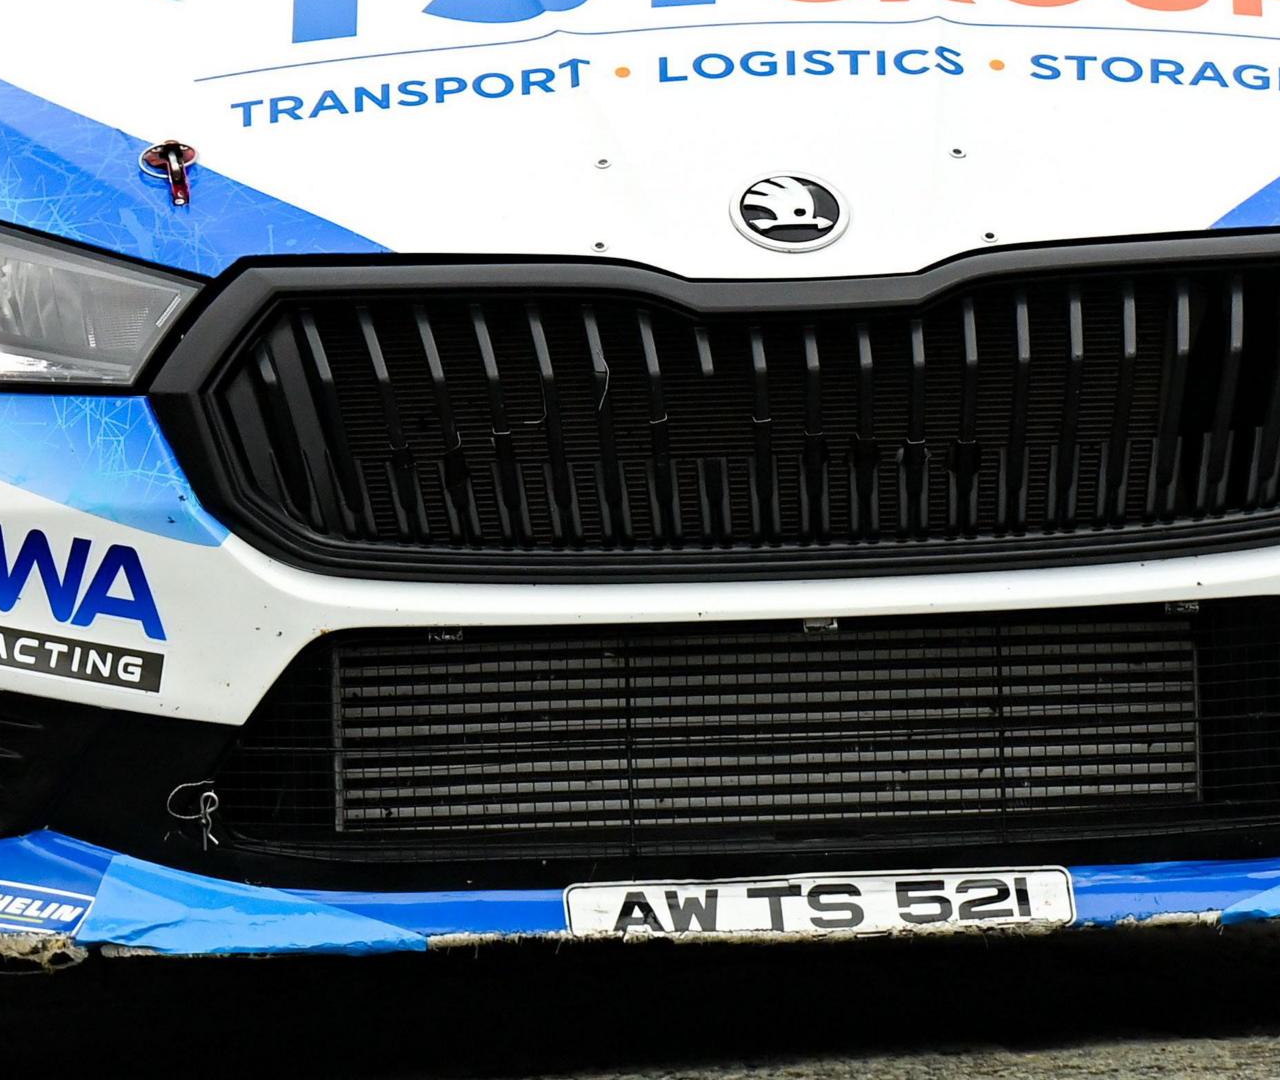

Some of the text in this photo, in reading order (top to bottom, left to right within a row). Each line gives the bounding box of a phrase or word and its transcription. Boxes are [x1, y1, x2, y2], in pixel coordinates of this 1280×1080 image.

[231, 57, 591, 128] TRANSPORT
[658, 45, 965, 84] LOGISTICS
[613, 887, 720, 933] AW
[746, 883, 864, 930] TS
